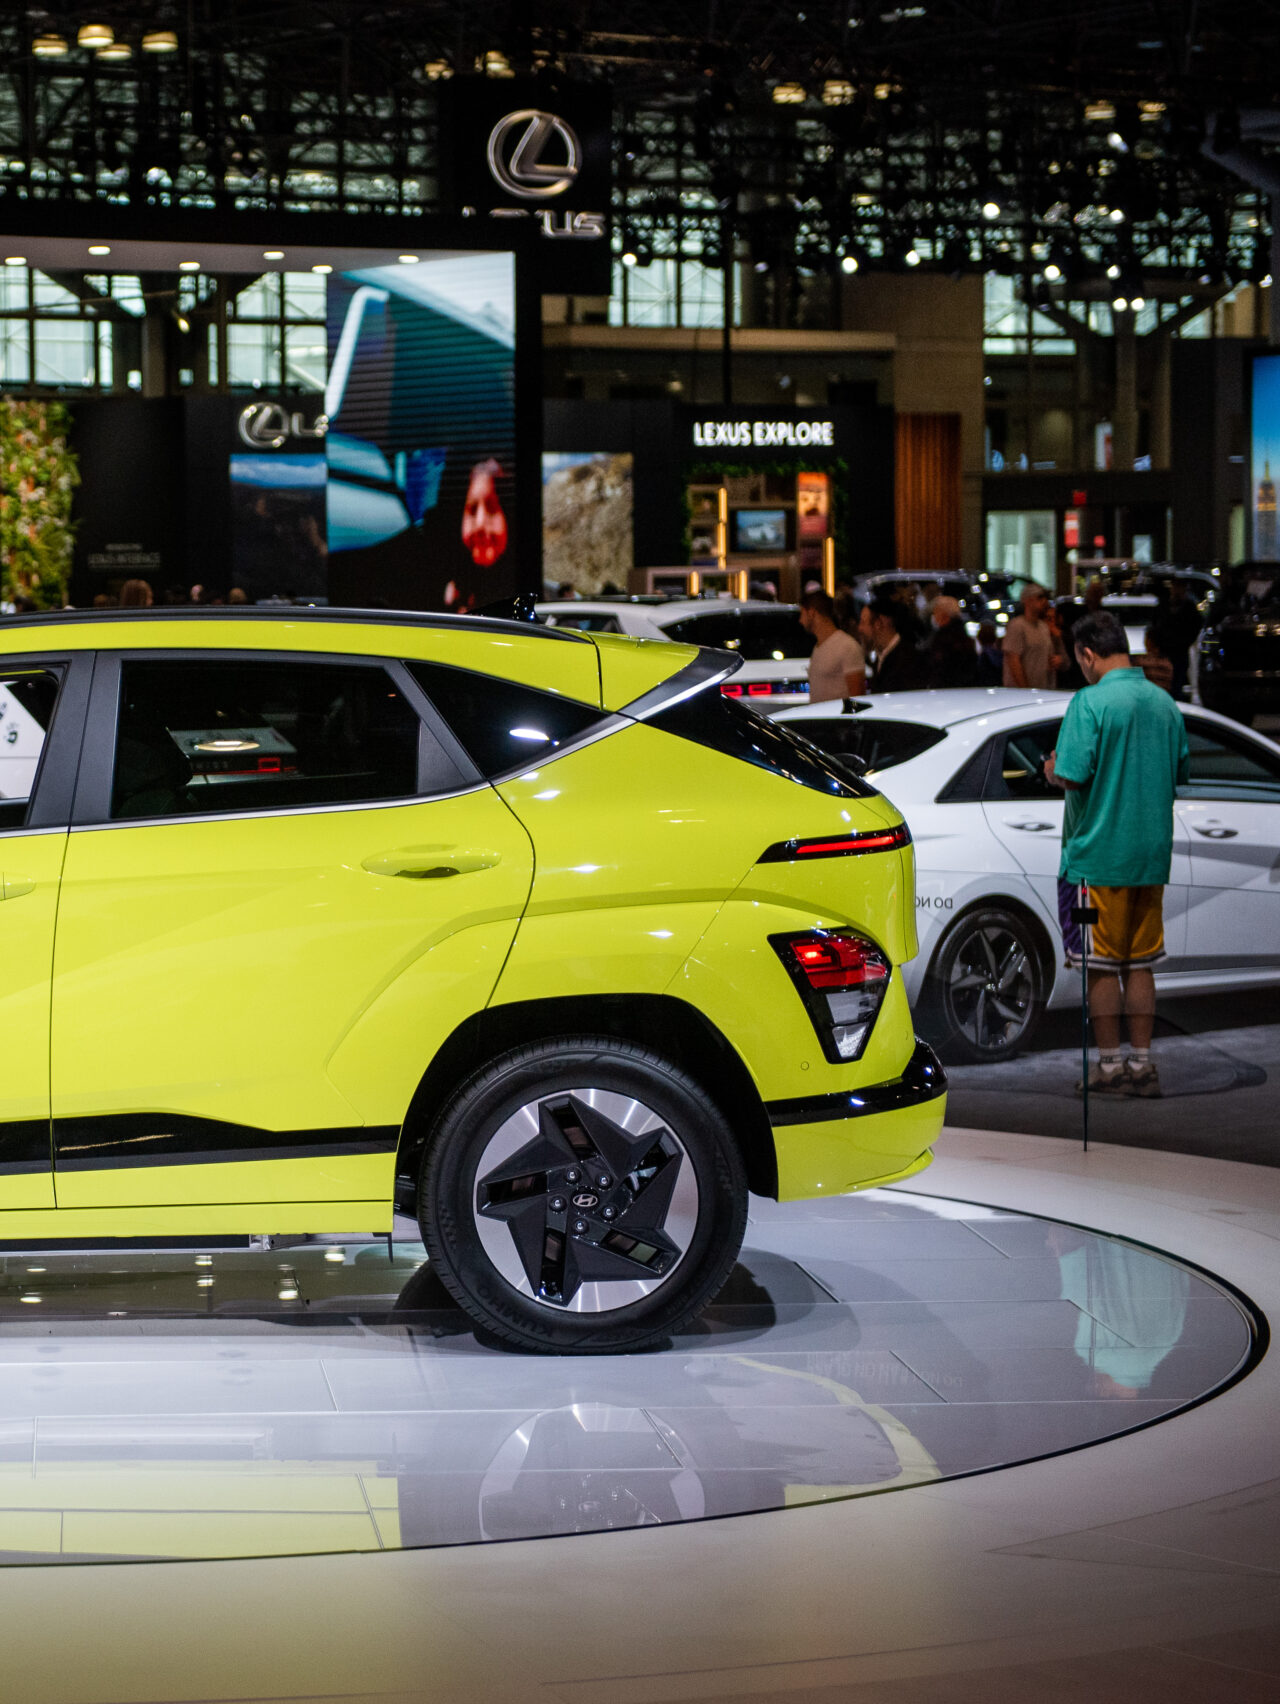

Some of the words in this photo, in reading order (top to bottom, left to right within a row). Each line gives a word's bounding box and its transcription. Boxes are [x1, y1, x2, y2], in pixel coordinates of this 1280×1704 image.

[693, 421, 752, 446] LEXUS
[753, 421, 834, 446] EXPLORE
[477, 1286, 554, 1338] KUMHO
